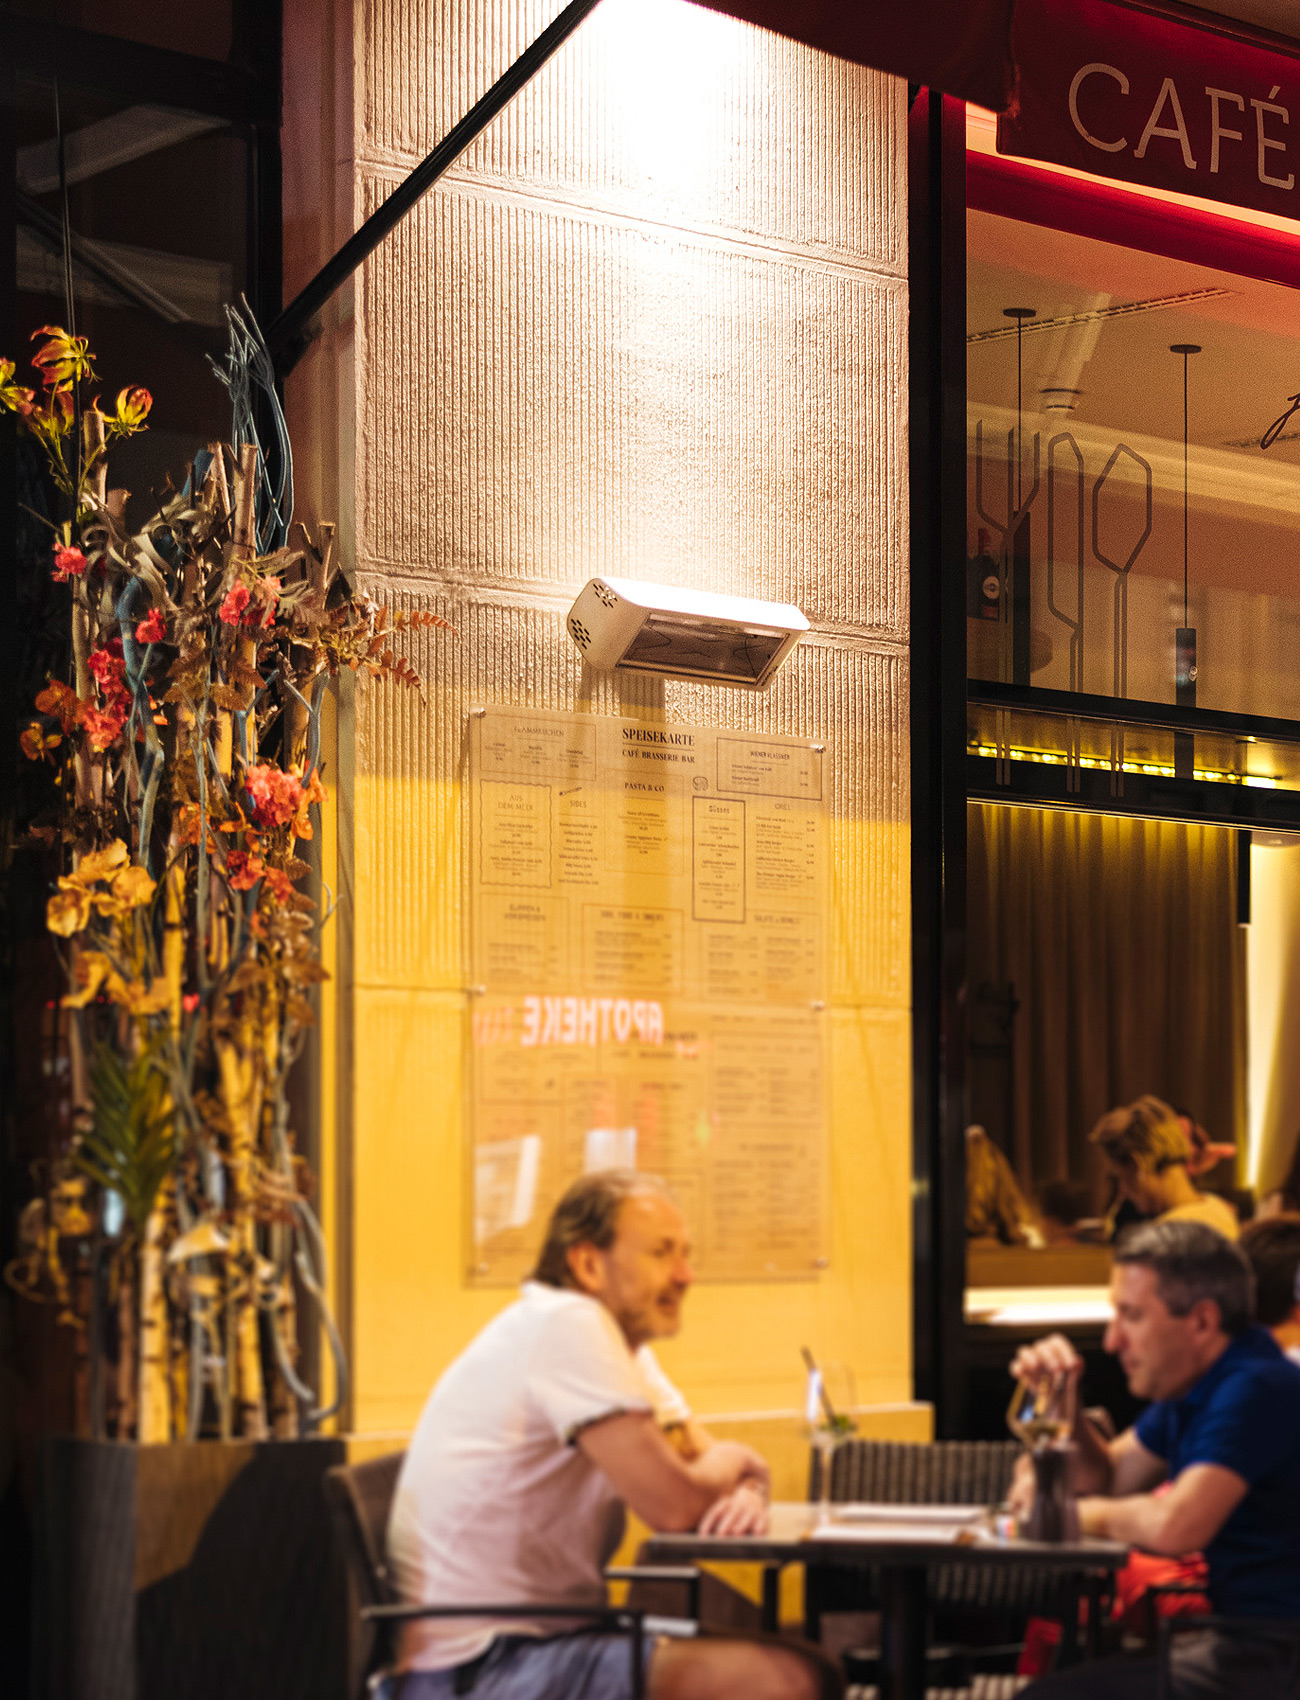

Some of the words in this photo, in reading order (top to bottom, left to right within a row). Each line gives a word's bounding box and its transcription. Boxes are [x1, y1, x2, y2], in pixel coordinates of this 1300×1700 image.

[1068, 62, 1295, 191] CAFÉ
[622, 727, 695, 747] SPEISEKARTE
[622, 748, 640, 758] CAFÉ
[641, 751, 679, 763] BRASSERIE
[681, 755, 695, 763] BAR
[624, 782, 647, 792] PASTA
[654, 785, 665, 793] CO
[569, 800, 588, 808] SIDES
